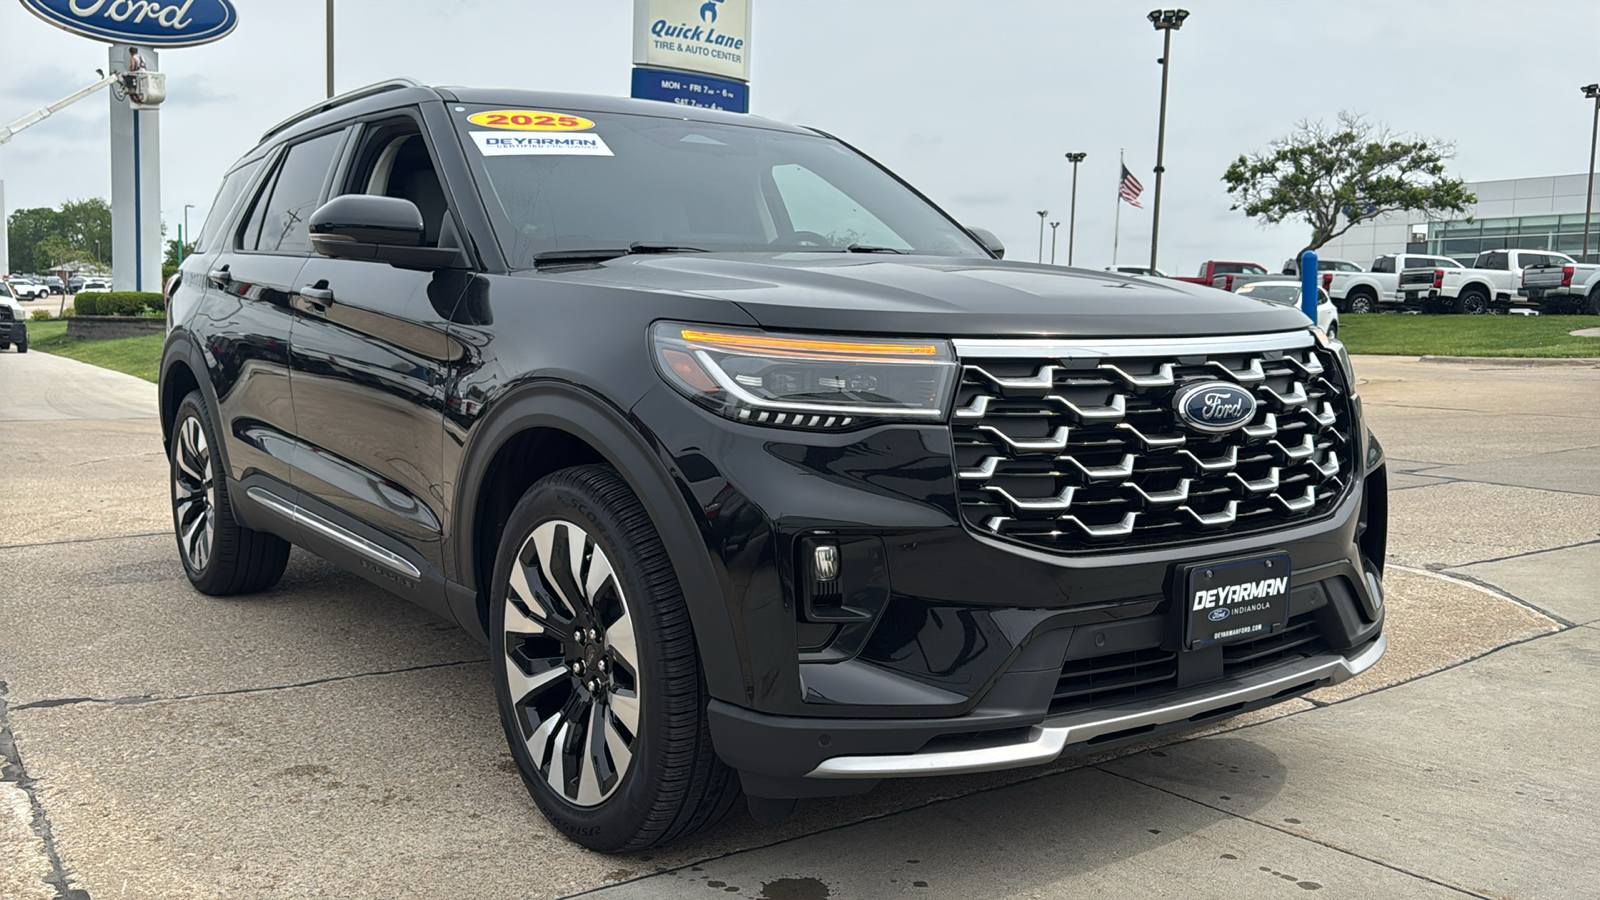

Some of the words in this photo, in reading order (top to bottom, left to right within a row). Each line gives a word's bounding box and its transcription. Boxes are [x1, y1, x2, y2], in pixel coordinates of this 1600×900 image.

[651, 19, 704, 41] Quick
[704, 28, 744, 50] Lane
[653, 40, 675, 51] TIRE
[676, 43, 684, 52] &
[685, 45, 710, 56] AUTO
[711, 49, 742, 63] CENTER
[661, 80, 680, 90] MON
[689, 83, 702, 93] FRI
[674, 97, 689, 106] SAT
[486, 114, 580, 127] 2025
[485, 137, 597, 146] DEYARMAN
[1201, 392, 1243, 420] Ford
[1192, 576, 1288, 611] DEYARMAN
[1231, 601, 1271, 616] INDIANOLA
